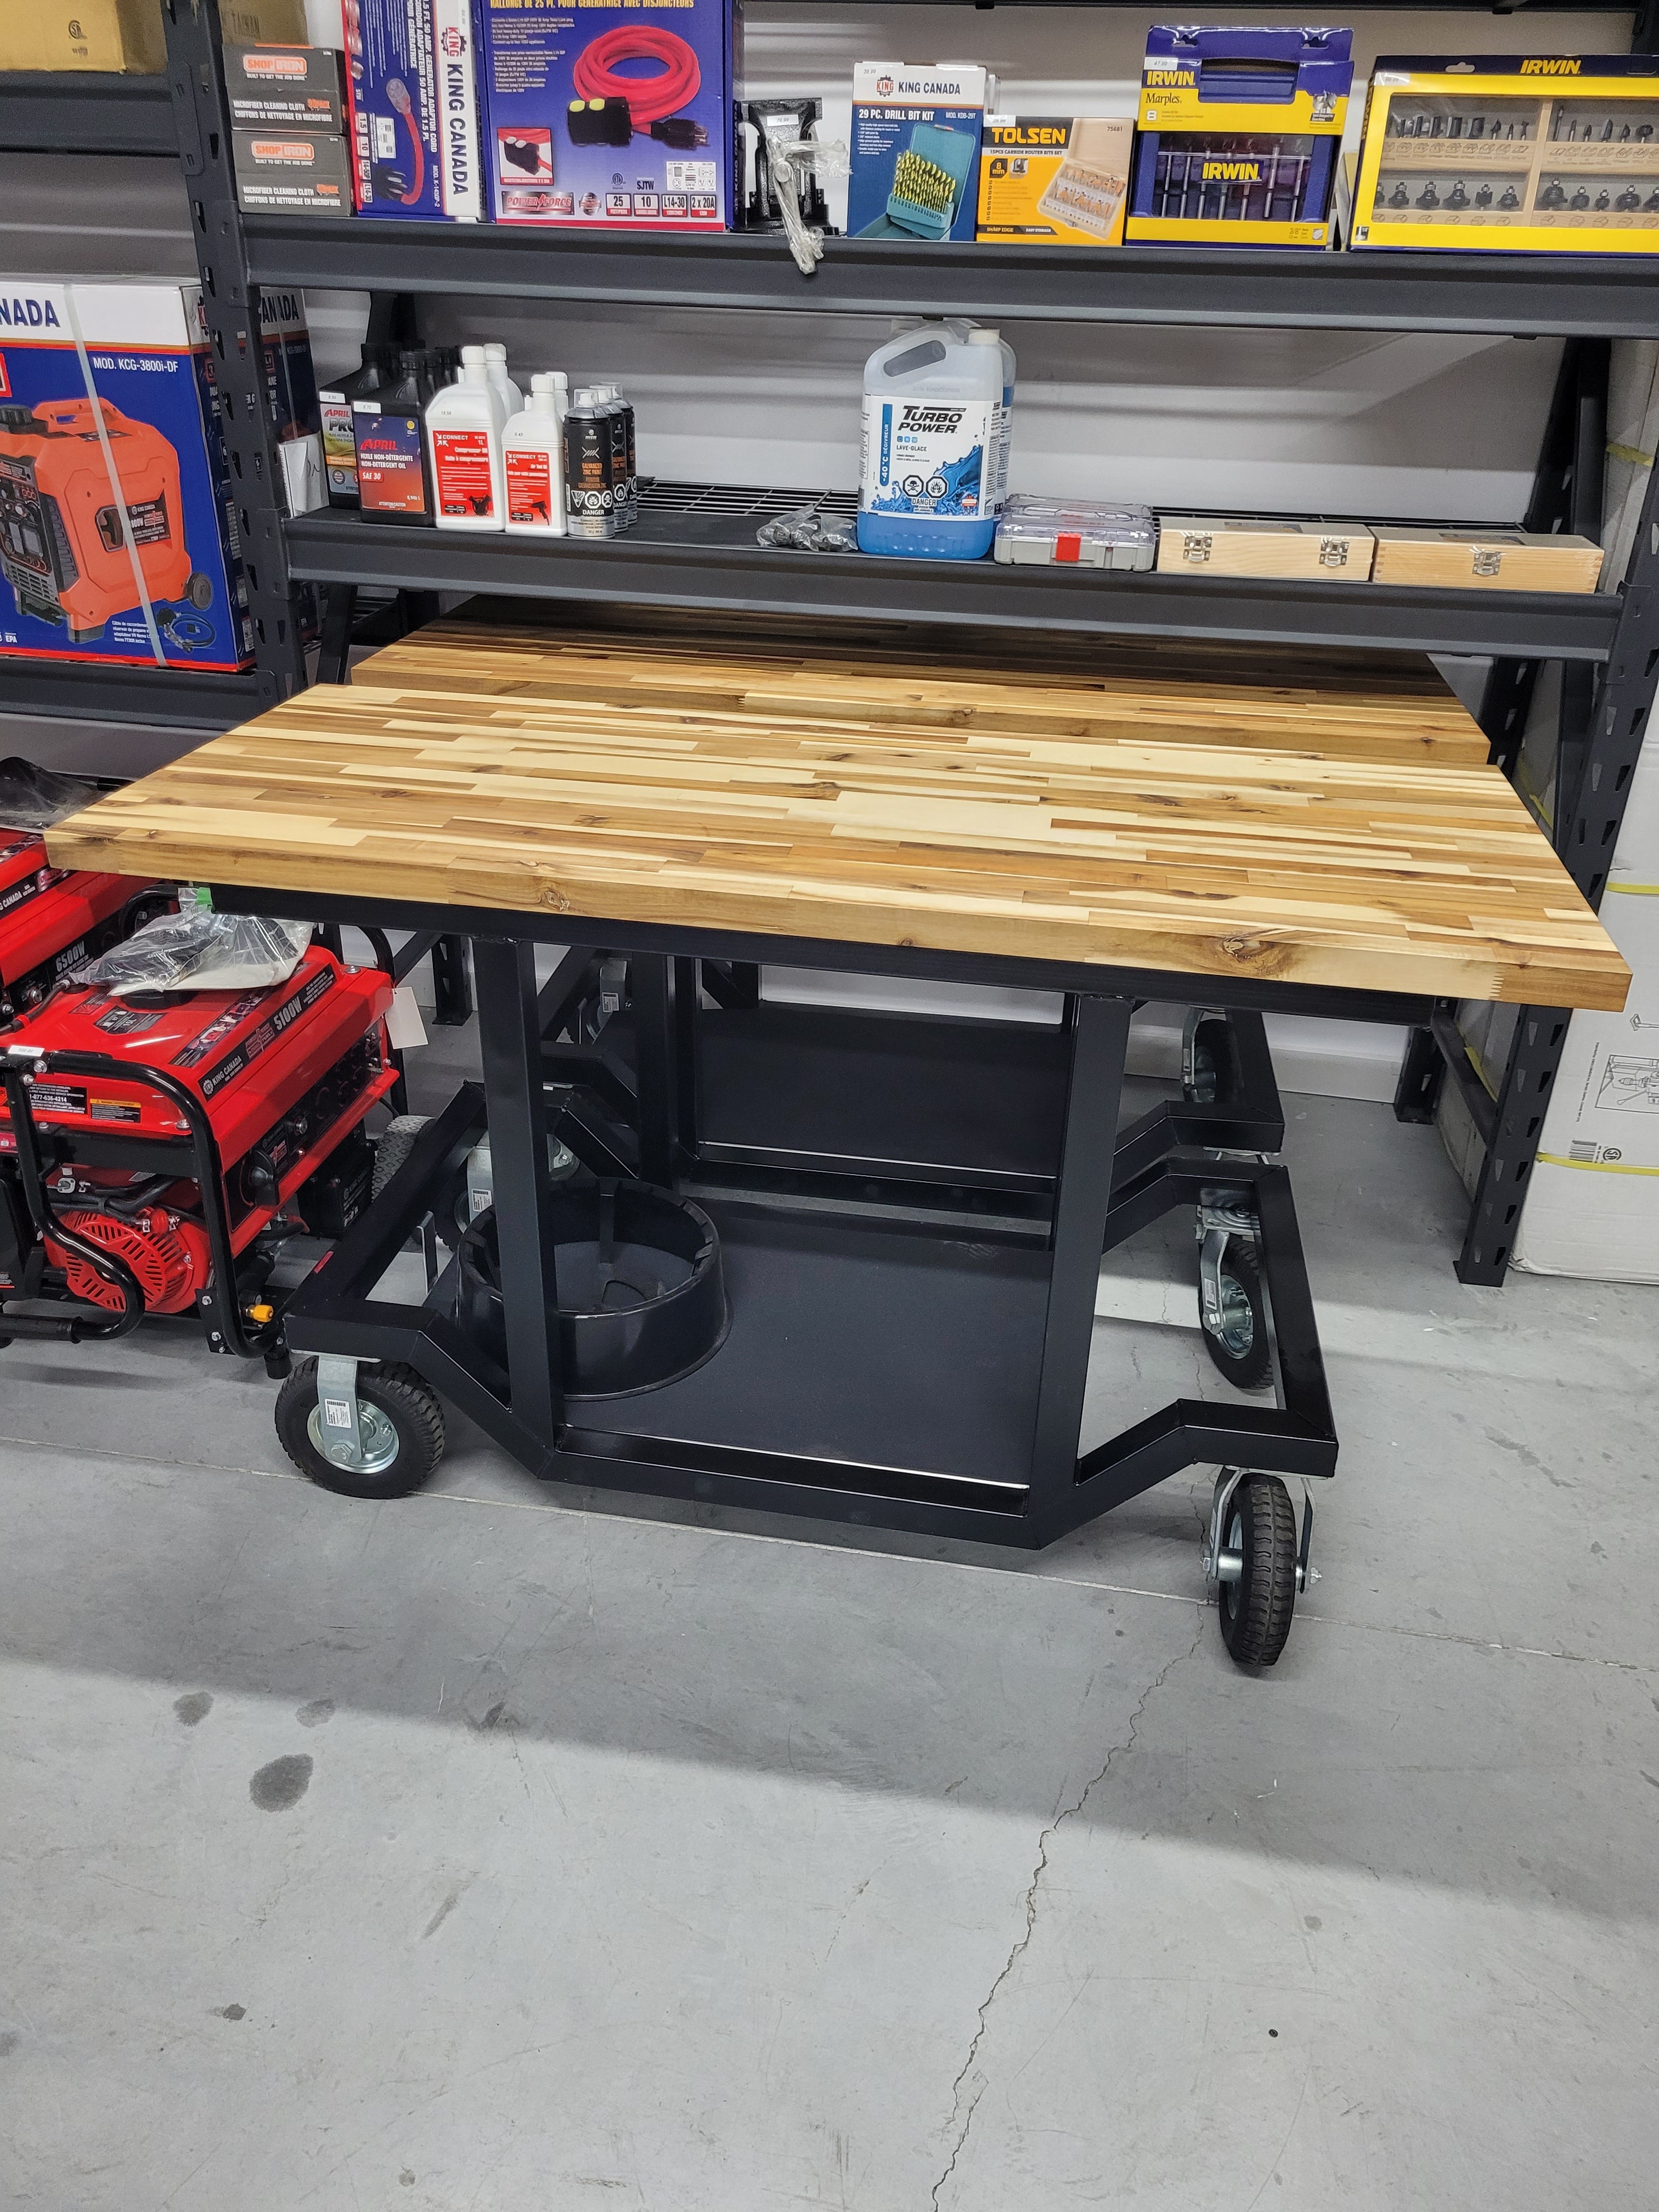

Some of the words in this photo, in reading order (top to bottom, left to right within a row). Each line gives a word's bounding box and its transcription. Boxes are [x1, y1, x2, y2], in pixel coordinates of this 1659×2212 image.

[408, 19, 417, 69] GÉNÉRATRICE
[447, 27, 460, 57] KING
[247, 59, 274, 69] SHOP
[276, 60, 304, 71] IRON
[1520, 59, 1581, 74] IRWIN
[416, 29, 425, 76] ADAPTATEUR
[421, 107, 427, 117] DE
[1147, 71, 1195, 86] IRWIN
[447, 64, 465, 111] KING
[877, 82, 894, 91] KING
[898, 81, 921, 94] KING
[923, 82, 961, 94] CANADA
[233, 100, 263, 109] MICROFIBER
[263, 102, 288, 110] CLEANING
[1146, 92, 1180, 106] Marples
[267, 112, 295, 120] NETTOYAGE
[428, 98, 436, 131] ADAPTOR
[859, 109, 870, 119] 29
[870, 109, 883, 119] PC.
[884, 110, 906, 120] DRILL
[908, 110, 920, 120] BIT
[922, 111, 935, 121] KIT
[991, 127, 1066, 144] TOLSEN
[256, 145, 281, 154] SHOP
[284, 146, 311, 157] IRON
[362, 142, 368, 151] 10
[449, 117, 469, 195] CANADA
[1202, 162, 1259, 180] IRWIN
[243, 186, 273, 195] MICROFIBER
[273, 187, 297, 196] CLEANING
[637, 180, 654, 190] SJTW
[276, 197, 304, 205] NETTOYAGE
[312, 199, 341, 207] MICROFIBRE
[507, 195, 538, 206] POWER
[545, 195, 572, 206] FORCE
[613, 195, 623, 207] 25
[641, 196, 651, 207] 10
[664, 196, 685, 208] L14-30
[692, 197, 696, 208] 2
[697, 199, 701, 208] x
[703, 197, 715, 208] 20A
[93, 357, 117, 370] MOD.
[119, 358, 178, 373] KCG-3800i-DF
[324, 409, 350, 417] APRIL
[902, 405, 966, 423] TURBO
[898, 422, 958, 434] POWER
[360, 439, 398, 451] APRIL
[131, 517, 144, 528] 800W
[3, 891, 23, 908] CANADA
[55, 940, 85, 972] 6500W
[273, 996, 302, 1030] 5100W
[212, 1071, 225, 1086] KING
[223, 1055, 242, 1075] CANADA
